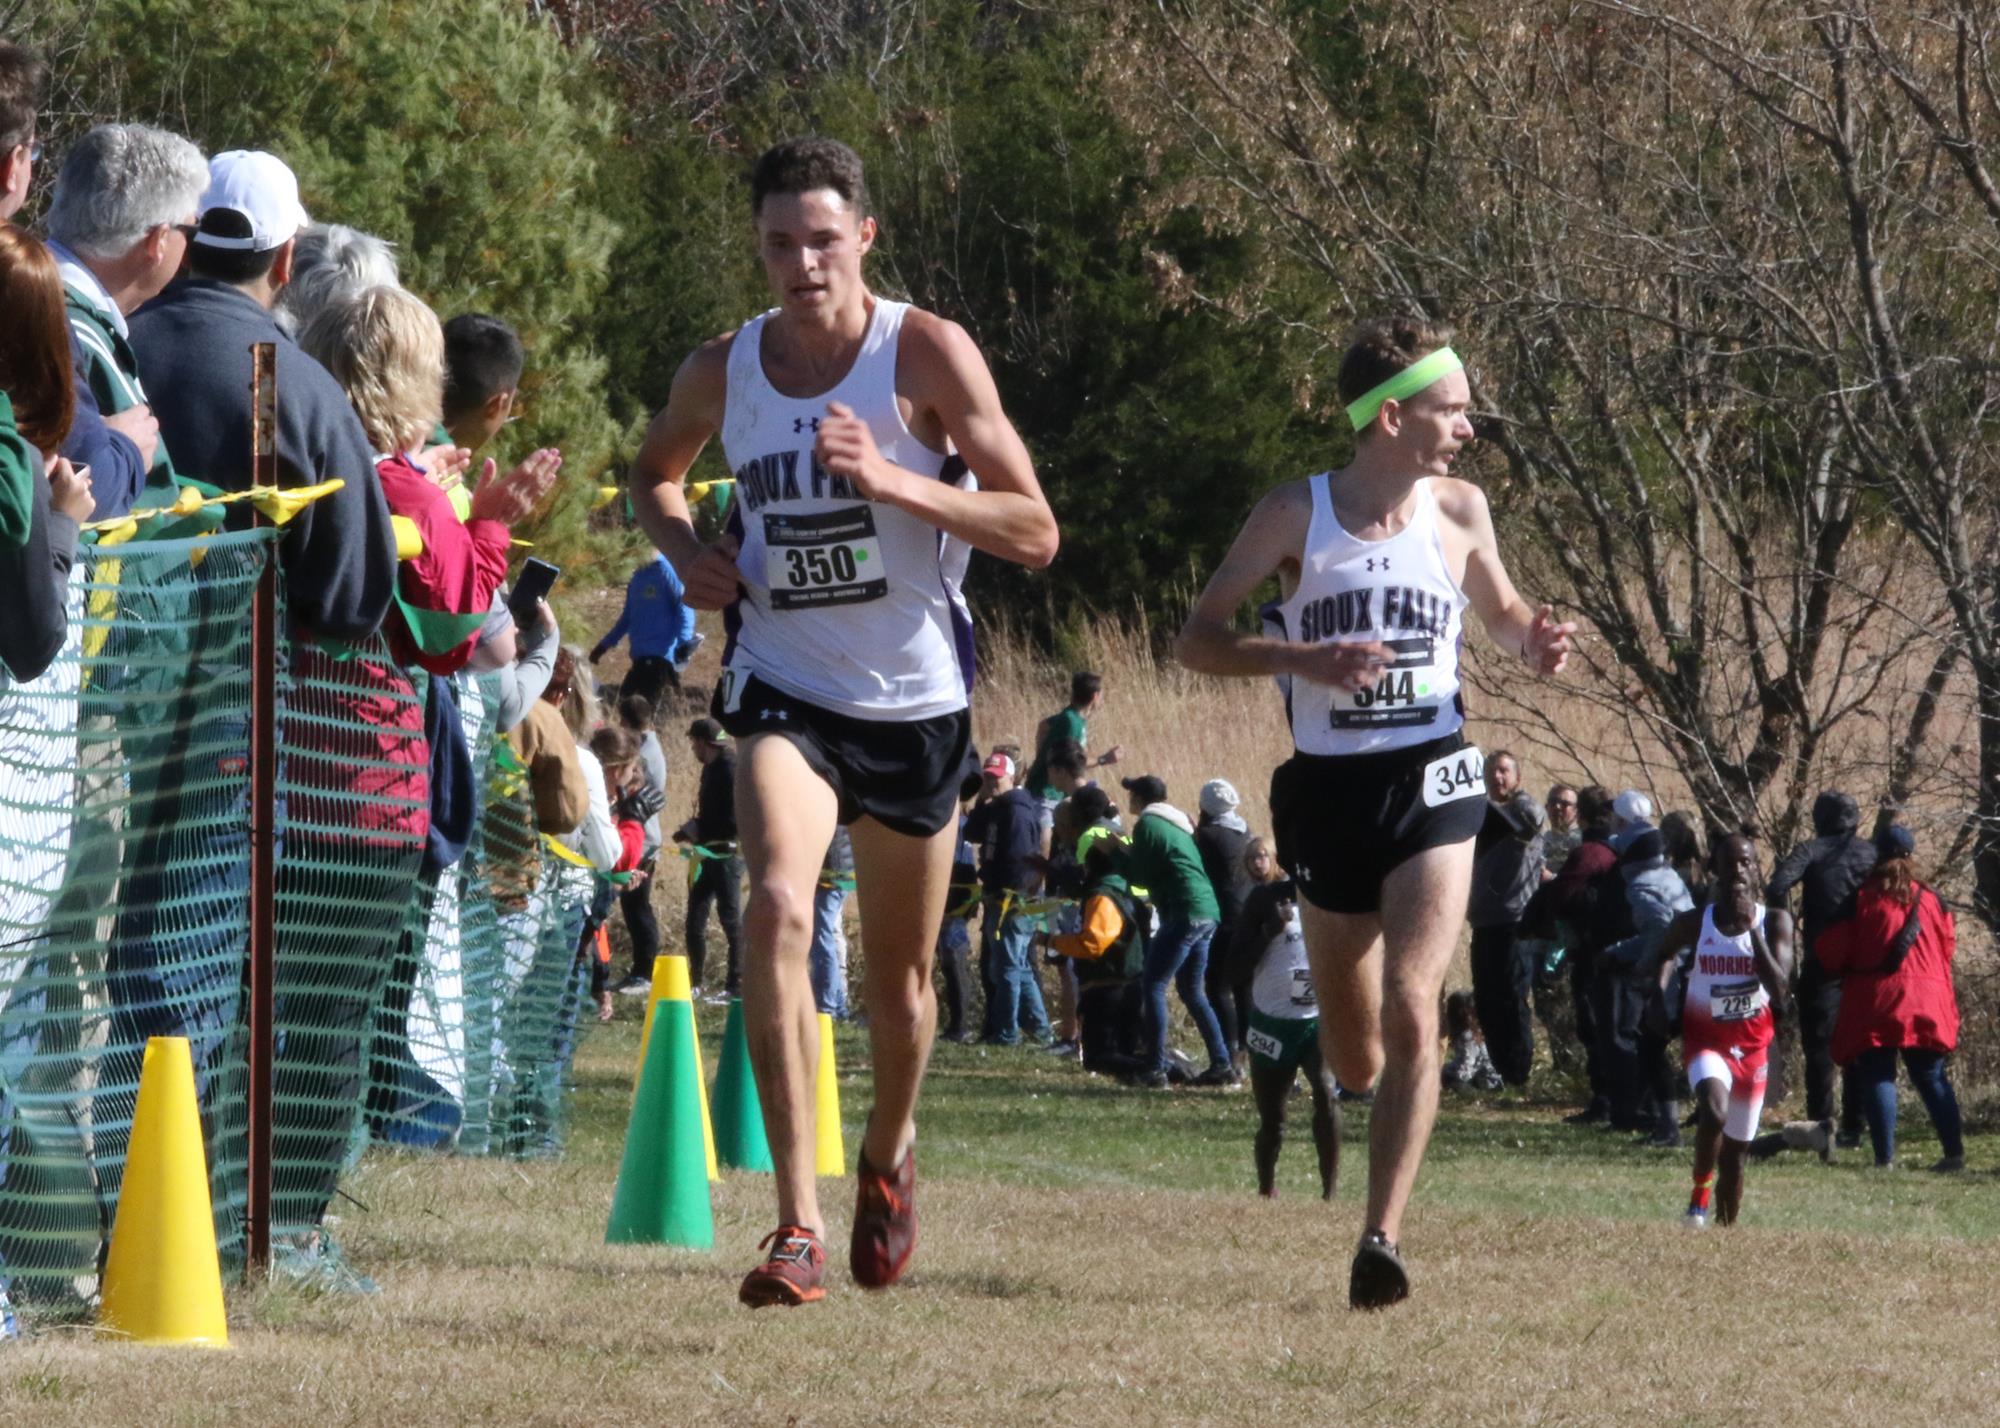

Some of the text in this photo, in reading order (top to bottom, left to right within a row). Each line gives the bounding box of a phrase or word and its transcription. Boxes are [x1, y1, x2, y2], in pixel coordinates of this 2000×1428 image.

[785, 544, 857, 588] 350
[1300, 586, 1451, 643] SIOUX FALLS
[1722, 995, 1751, 1014] 229
[1250, 1031, 1276, 1056] 294
